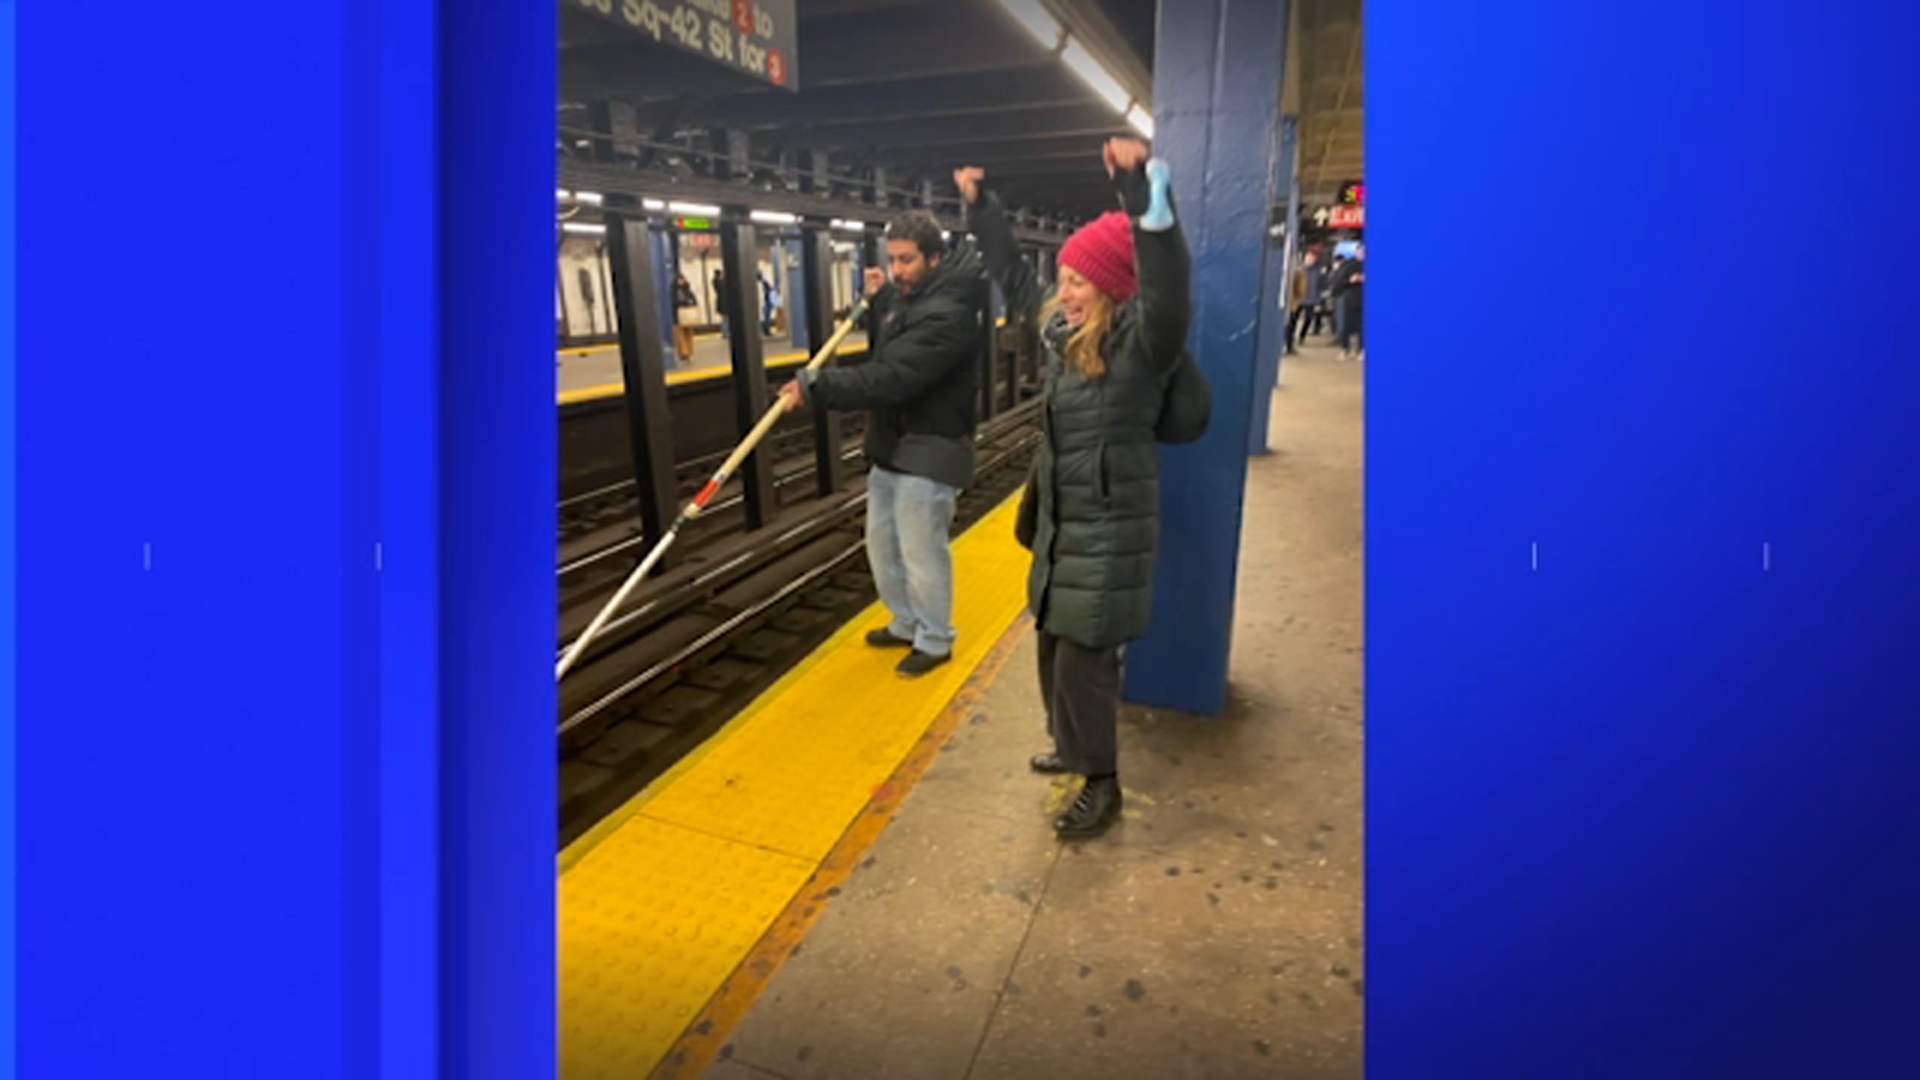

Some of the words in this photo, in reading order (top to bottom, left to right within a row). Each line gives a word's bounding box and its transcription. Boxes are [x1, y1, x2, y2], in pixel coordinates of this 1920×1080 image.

[622, 0, 702, 49] Sq-42
[708, 19, 733, 61] St
[739, 34, 766, 73] for
[768, 50, 784, 82] 3
[734, 0, 751, 31] 2
[754, 3, 774, 39] to
